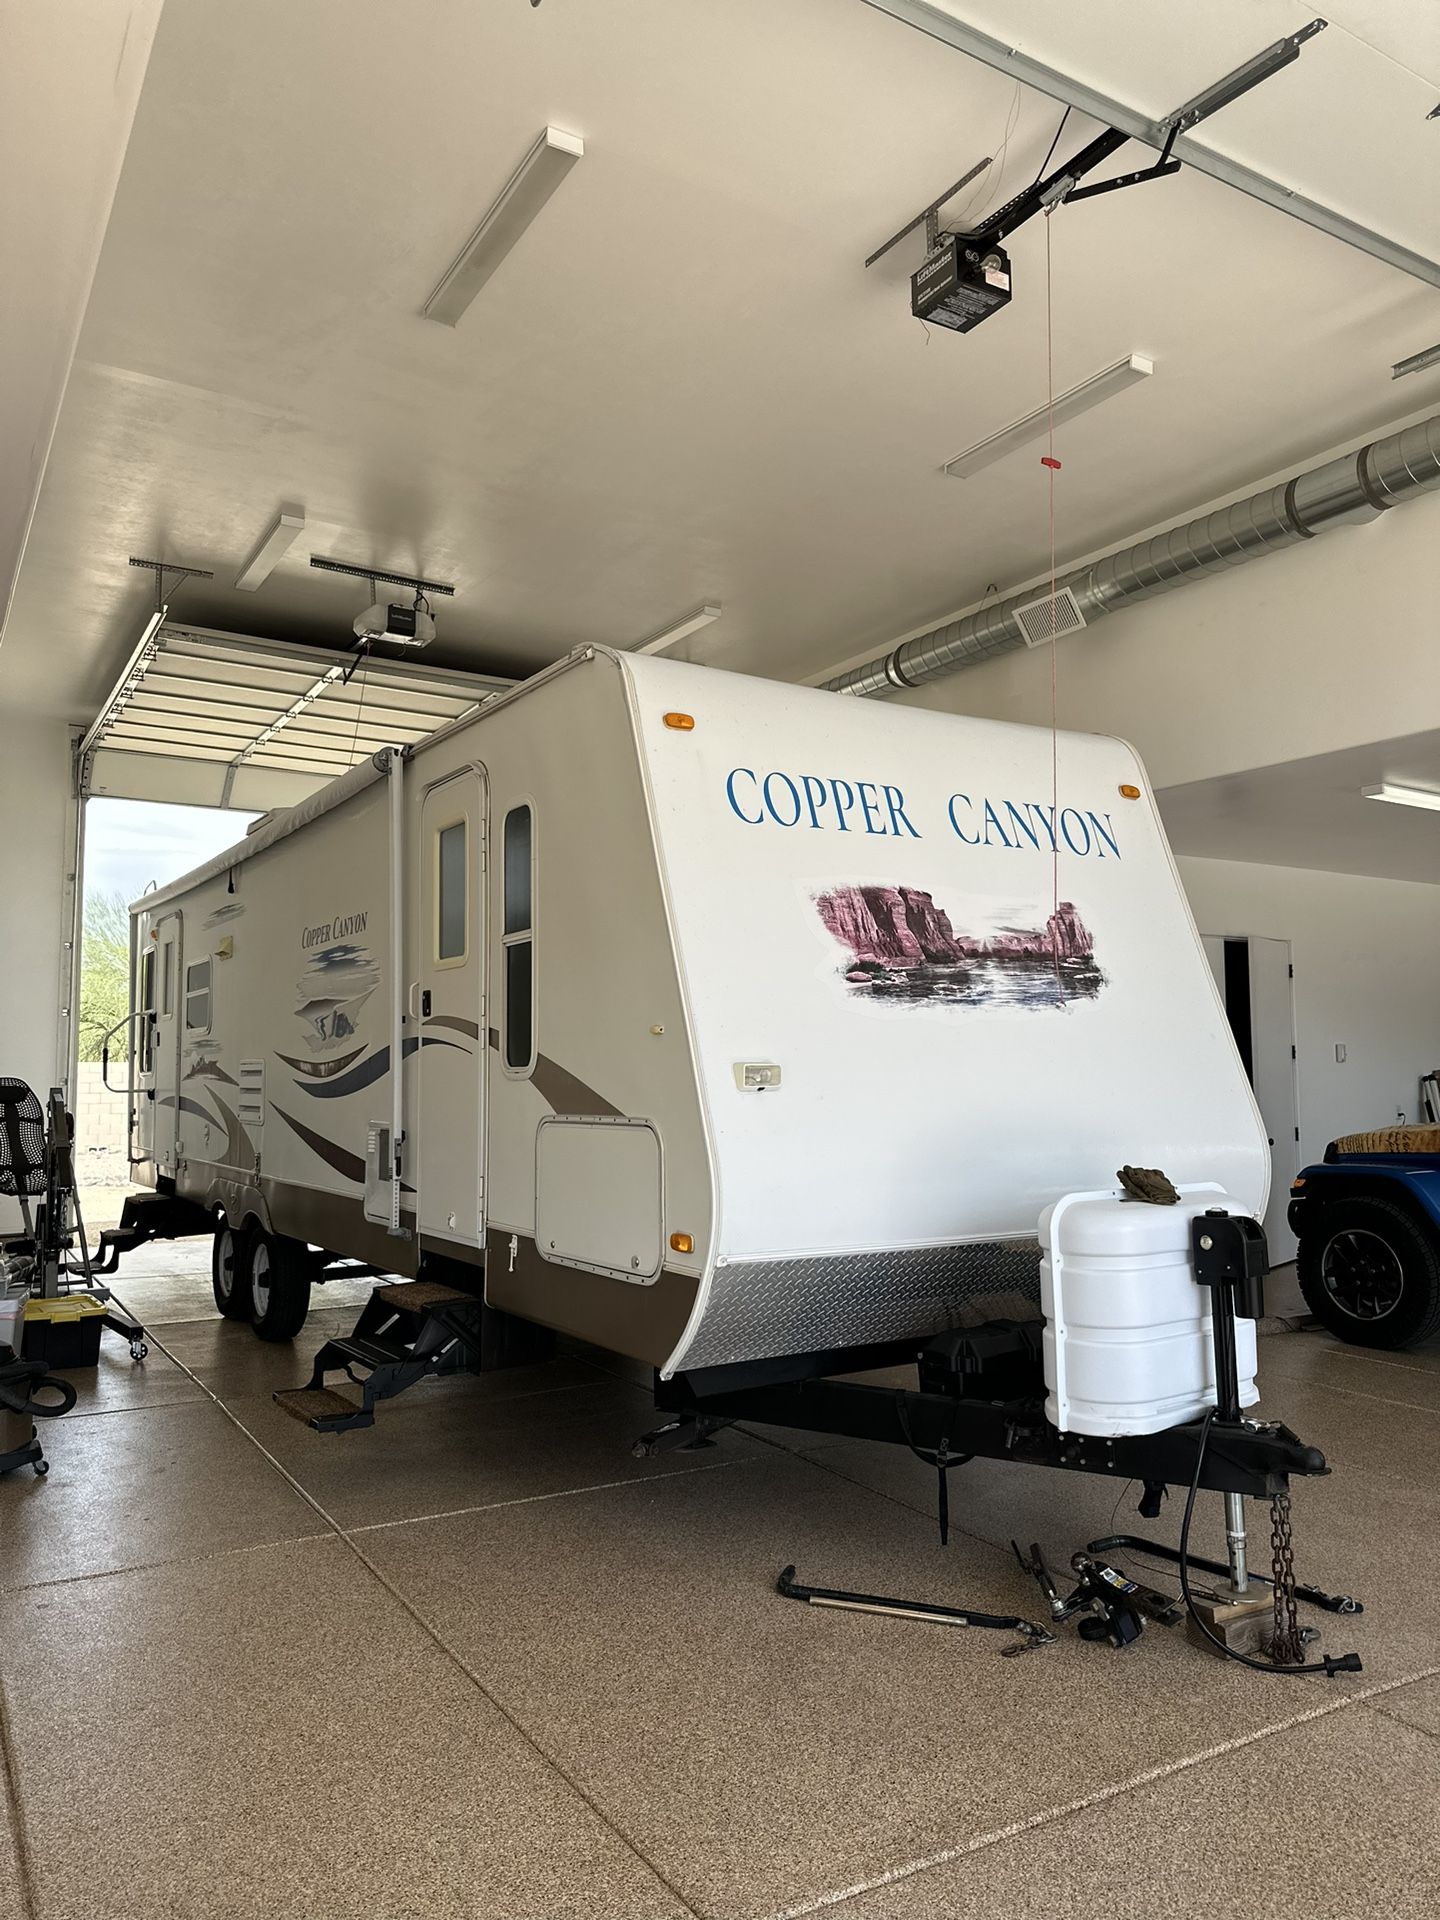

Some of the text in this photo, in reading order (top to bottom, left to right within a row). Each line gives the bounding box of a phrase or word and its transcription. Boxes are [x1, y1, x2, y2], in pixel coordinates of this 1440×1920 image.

[726, 768, 1121, 860] COPPER CANYON
[302, 911, 368, 949] COPPER CANYON
